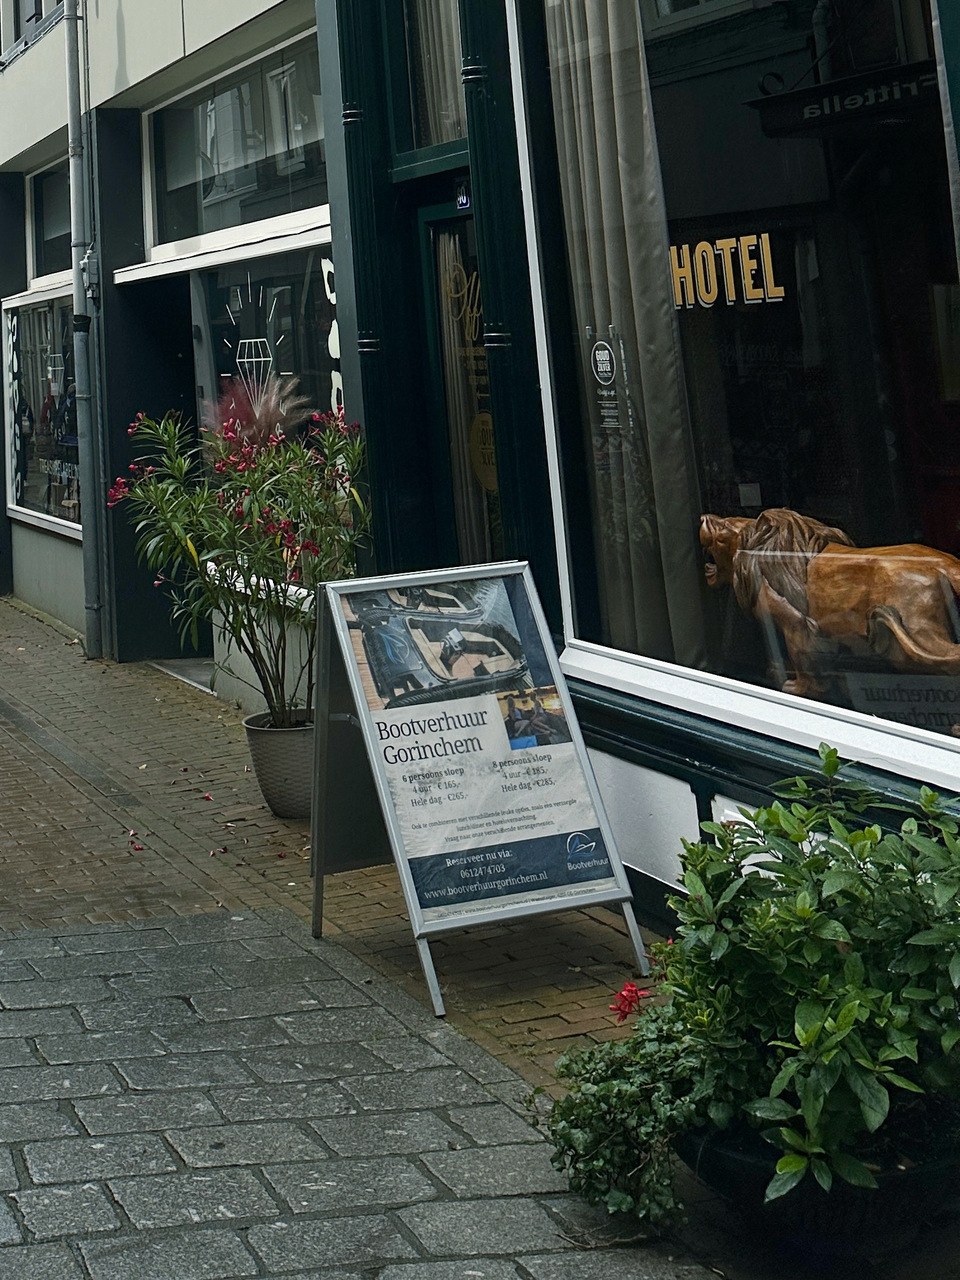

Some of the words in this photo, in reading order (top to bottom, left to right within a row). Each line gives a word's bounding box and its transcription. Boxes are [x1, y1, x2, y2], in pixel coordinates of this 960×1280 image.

[669, 232, 785, 309] HOTEL
[375, 710, 488, 741] Bootverhuur
[383, 735, 483, 765] Gorinchem
[499, 757, 531, 769] persoons
[532, 754, 552, 762] sloep
[408, 770, 444, 783] persoons
[444, 767, 465, 777] sloep
[419, 785, 432, 793] uur
[501, 783, 518, 793] Hele
[518, 782, 532, 790] dag
[410, 797, 428, 807] Hele
[429, 796, 443, 805] dag
[445, 853, 484, 867] Reserveer
[486, 851, 498, 861] nu
[498, 848, 513, 858] via:
[567, 857, 609, 871] Bootverhuur
[460, 863, 506, 879] 0612474703
[424, 871, 549, 899] www.bootverhuurgorinchem.nl
